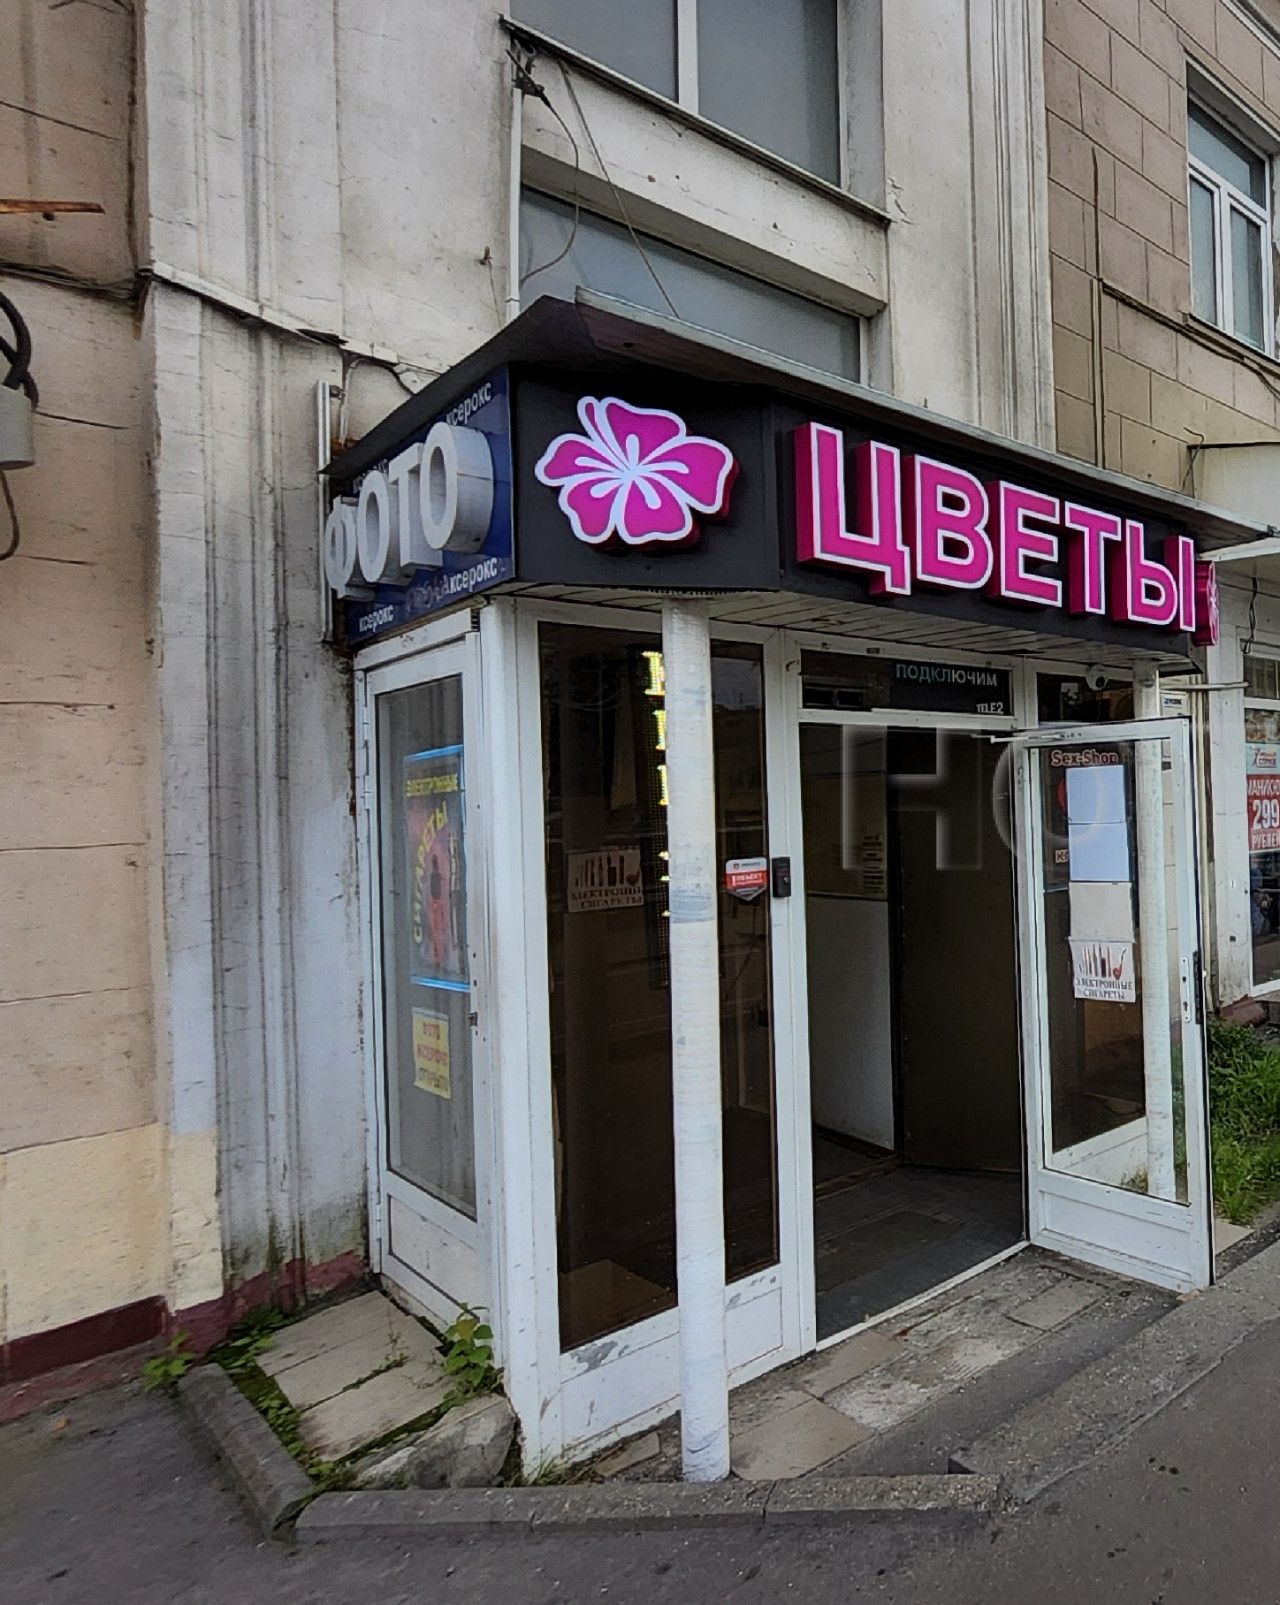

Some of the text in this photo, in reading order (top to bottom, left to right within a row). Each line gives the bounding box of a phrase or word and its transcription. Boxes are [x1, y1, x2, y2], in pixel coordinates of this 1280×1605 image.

[324, 422, 470, 600] ФОТО
[797, 421, 1197, 633] ЦВЕТЫ
[895, 662, 998, 688] ПОДКЛЮЧИМ
[976, 701, 1004, 716] TELE2
[1252, 799, 1280, 830] 299
